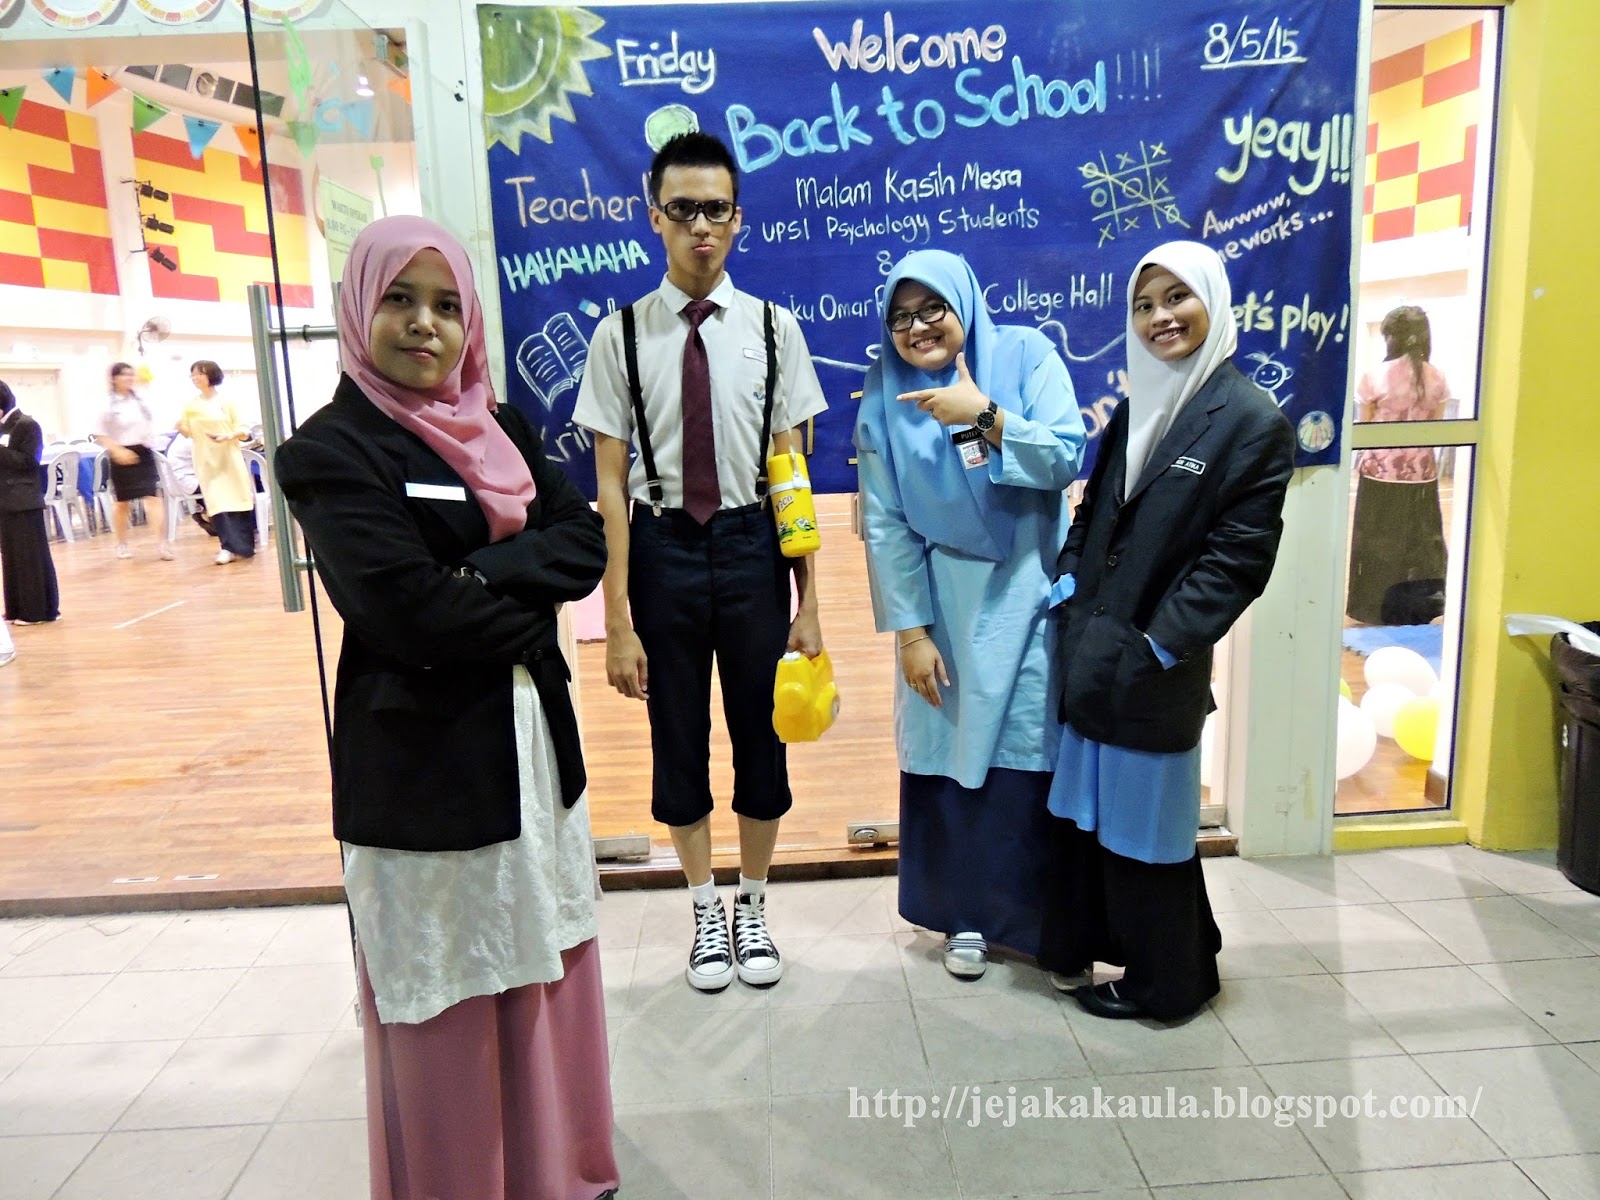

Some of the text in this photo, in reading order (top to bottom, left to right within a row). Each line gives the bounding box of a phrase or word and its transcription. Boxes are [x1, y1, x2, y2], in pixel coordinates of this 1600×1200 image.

[616, 31, 717, 95] Friday
[813, 11, 1007, 74] Welcome
[1203, 15, 1301, 63] 8/5/15
[725, 82, 873, 173] Back
[877, 86, 946, 145] to
[954, 55, 1107, 127] School
[504, 168, 641, 228] Teacher
[795, 162, 1023, 210] Malam Kasih Mesra
[762, 217, 810, 243] UPSI
[826, 213, 930, 246] Psychology
[500, 239, 650, 294] HAHAHAHA
[819, 293, 873, 321] Omar
[983, 277, 1065, 321] College
[1070, 271, 1113, 310] Hall
